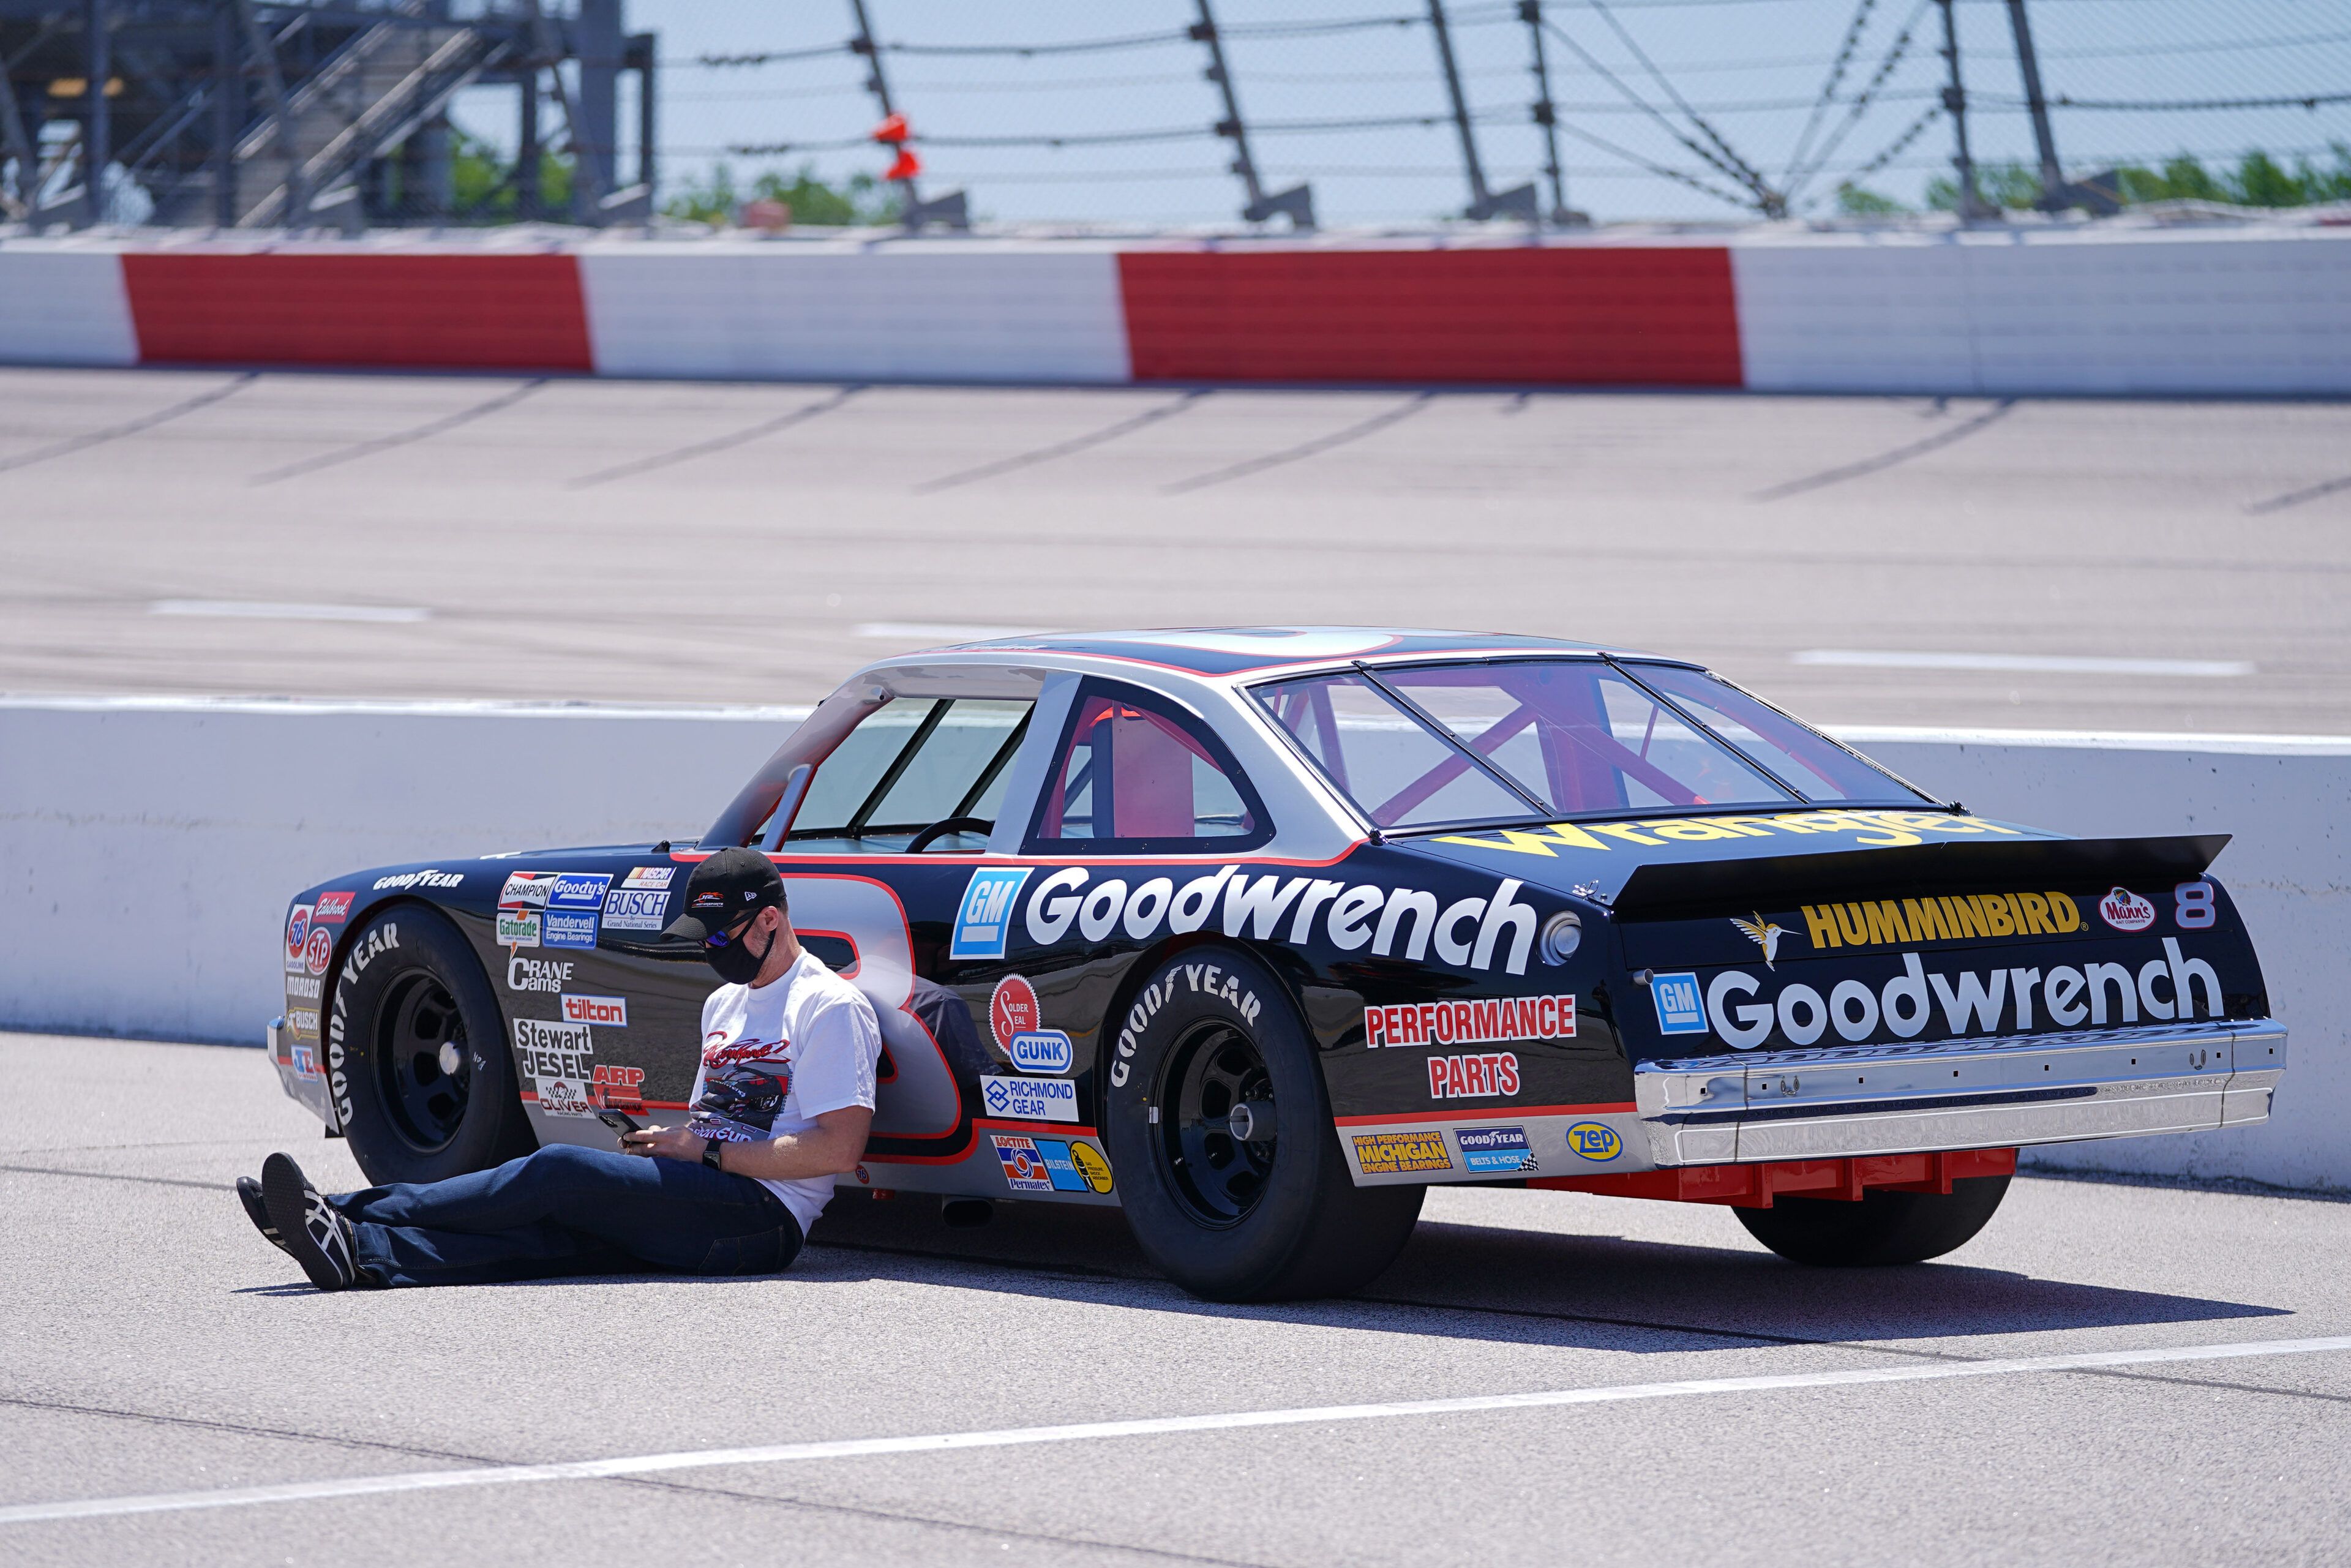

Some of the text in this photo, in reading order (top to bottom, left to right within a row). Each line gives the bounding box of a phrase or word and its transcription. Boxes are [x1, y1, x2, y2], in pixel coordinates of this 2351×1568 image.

[1429, 809, 2022, 857] Wrangler
[643, 867, 672, 879] NASCAR
[505, 883, 549, 897] CHAMPION
[554, 880, 606, 900] Goody's
[316, 898, 350, 917] Edelbrock
[605, 892, 669, 915] BUSCH
[966, 881, 1015, 924] GM
[2105, 901, 2151, 920] Mann's
[2175, 882, 2216, 929] 8
[500, 919, 537, 936] Gatorade
[547, 914, 594, 929] Vandervell
[1026, 865, 1537, 975] Goodwrench
[290, 918, 307, 947] 76
[547, 931, 593, 943] Engine Bearings
[308, 933, 328, 966] STP
[287, 976, 320, 999] MOROSO
[1707, 937, 2224, 1049] Goodwrench
[1660, 983, 1696, 1013] GM
[566, 998, 623, 1022] tilton
[296, 1011, 318, 1030] BUSCH
[1365, 994, 1577, 1048] PERFORMANCE
[518, 1021, 590, 1051] Stewart
[1016, 1040, 1064, 1060] GUNK
[525, 1051, 590, 1079] JESEL
[592, 1065, 645, 1087] ARP
[1427, 1052, 1520, 1099] PARTS
[1010, 1081, 1073, 1099] RICHMOND
[540, 1098, 592, 1113] OLIVER
[1013, 1100, 1046, 1116] GEAR
[996, 1136, 1030, 1149] LOCTITE
[1353, 1132, 1442, 1146] HIGH PERFORMANCE
[1357, 1142, 1448, 1163] MICHIGAN
[1499, 1155, 1521, 1164] HOSE
[857, 1169, 868, 1180] 76
[1361, 1159, 1451, 1173] ENGINE BEARINGS
[1010, 1179, 1050, 1191] Permatex
